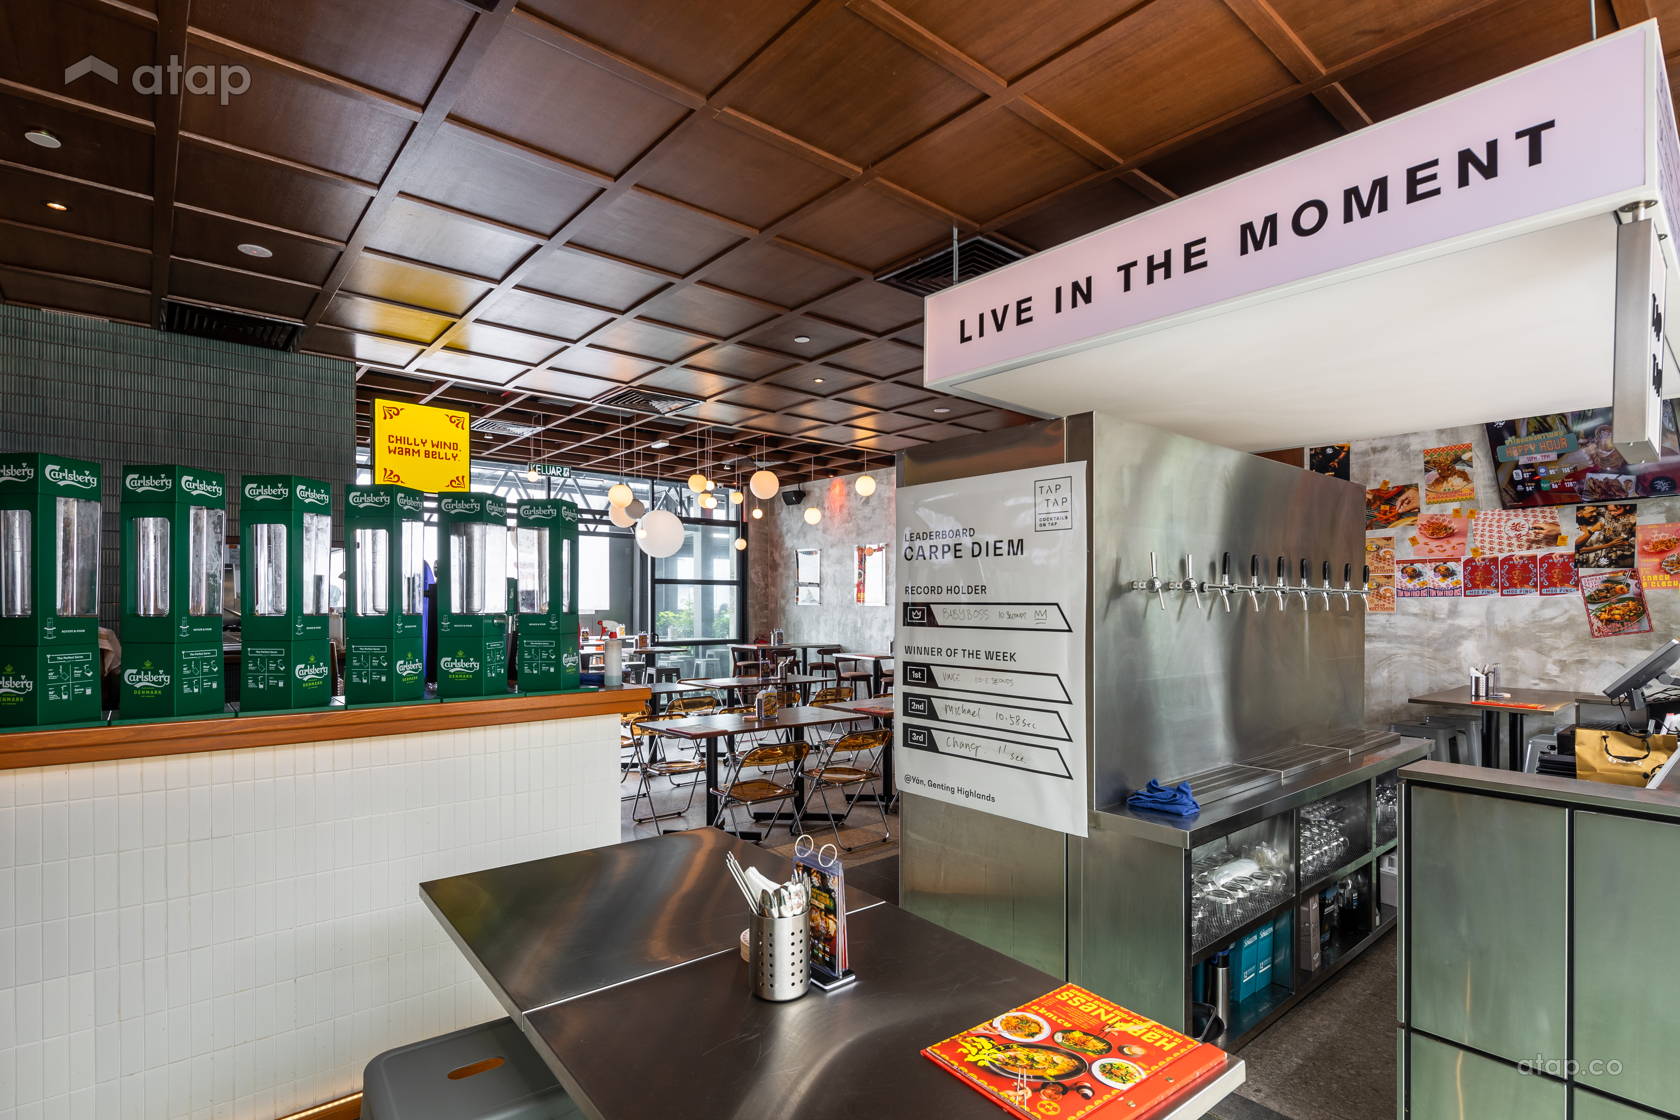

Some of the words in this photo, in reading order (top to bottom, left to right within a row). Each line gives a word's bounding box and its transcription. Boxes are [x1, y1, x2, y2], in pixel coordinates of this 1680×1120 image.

[959, 296, 1034, 344] LIVE
[1055, 275, 1093, 314] IN
[1117, 236, 1209, 293] THE
[1240, 118, 1556, 256] MOMENT
[387, 434, 429, 448] CHILLY
[1538, 437, 1568, 452] HOUR
[45, 464, 97, 489] Carlsberg
[126, 473, 172, 493] Carlsberg
[181, 475, 222, 498] Carlsberg
[244, 483, 289, 501] Carlsberg
[296, 484, 329, 505] Carlsberg
[1038, 483, 1062, 495] TAP
[349, 491, 391, 509] Carlsberg
[397, 492, 423, 512] Carlsberg
[440, 498, 481, 514] Carlsberg
[1044, 496, 1068, 508] TAP
[519, 504, 557, 520] Carlsberg
[904, 527, 975, 542] LEADERBOARD
[903, 542, 963, 561] CARPE
[971, 538, 1025, 557] DIEM
[904, 586, 943, 596] RECORD
[946, 585, 987, 595] HOLDER
[904, 645, 943, 658] WINNER
[946, 648, 959, 658] OF
[961, 649, 981, 660] THE
[984, 651, 1017, 663] WEEK
[295, 662, 328, 681] Carlsberg
[396, 658, 423, 676] Carlsberg
[440, 656, 480, 673] Carlsberg
[124, 669, 170, 688] Carlsberg
[911, 671, 922, 680] 1st
[911, 702, 925, 711] 2nd
[911, 733, 924, 742] 3rd
[927, 779, 955, 795] Genting
[956, 786, 996, 803] Highlands
